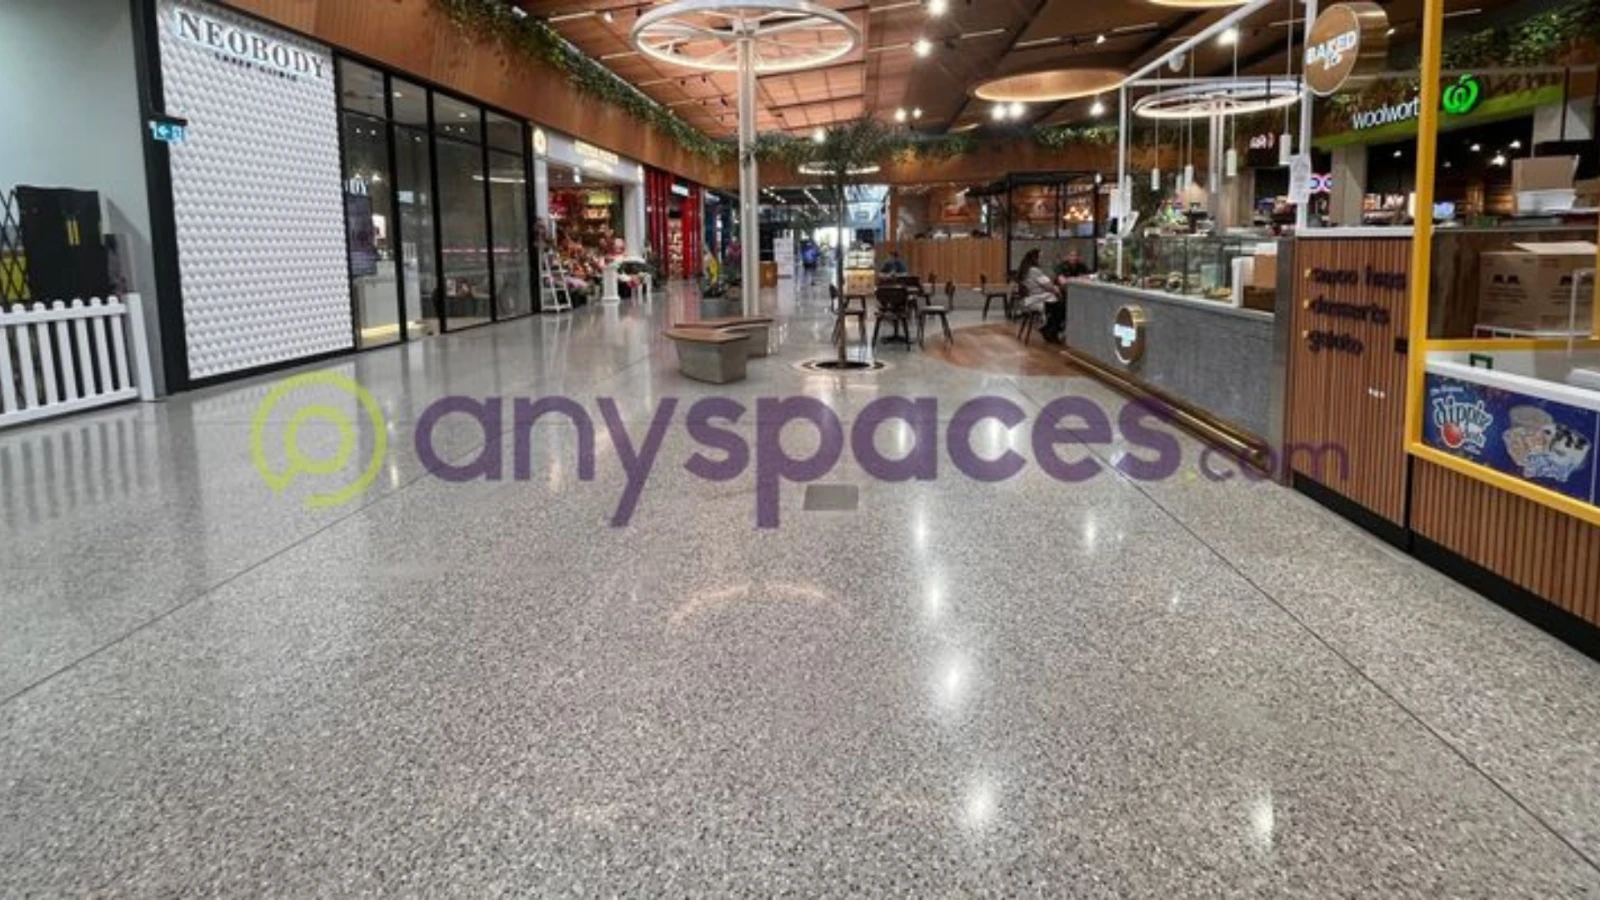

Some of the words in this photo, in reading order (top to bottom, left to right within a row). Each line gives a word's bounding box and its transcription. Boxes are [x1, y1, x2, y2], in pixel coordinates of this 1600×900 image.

[177, 10, 325, 77] NEOBODY
[1304, 30, 1358, 66] BAKED
[1352, 97, 1420, 129] woolwort
